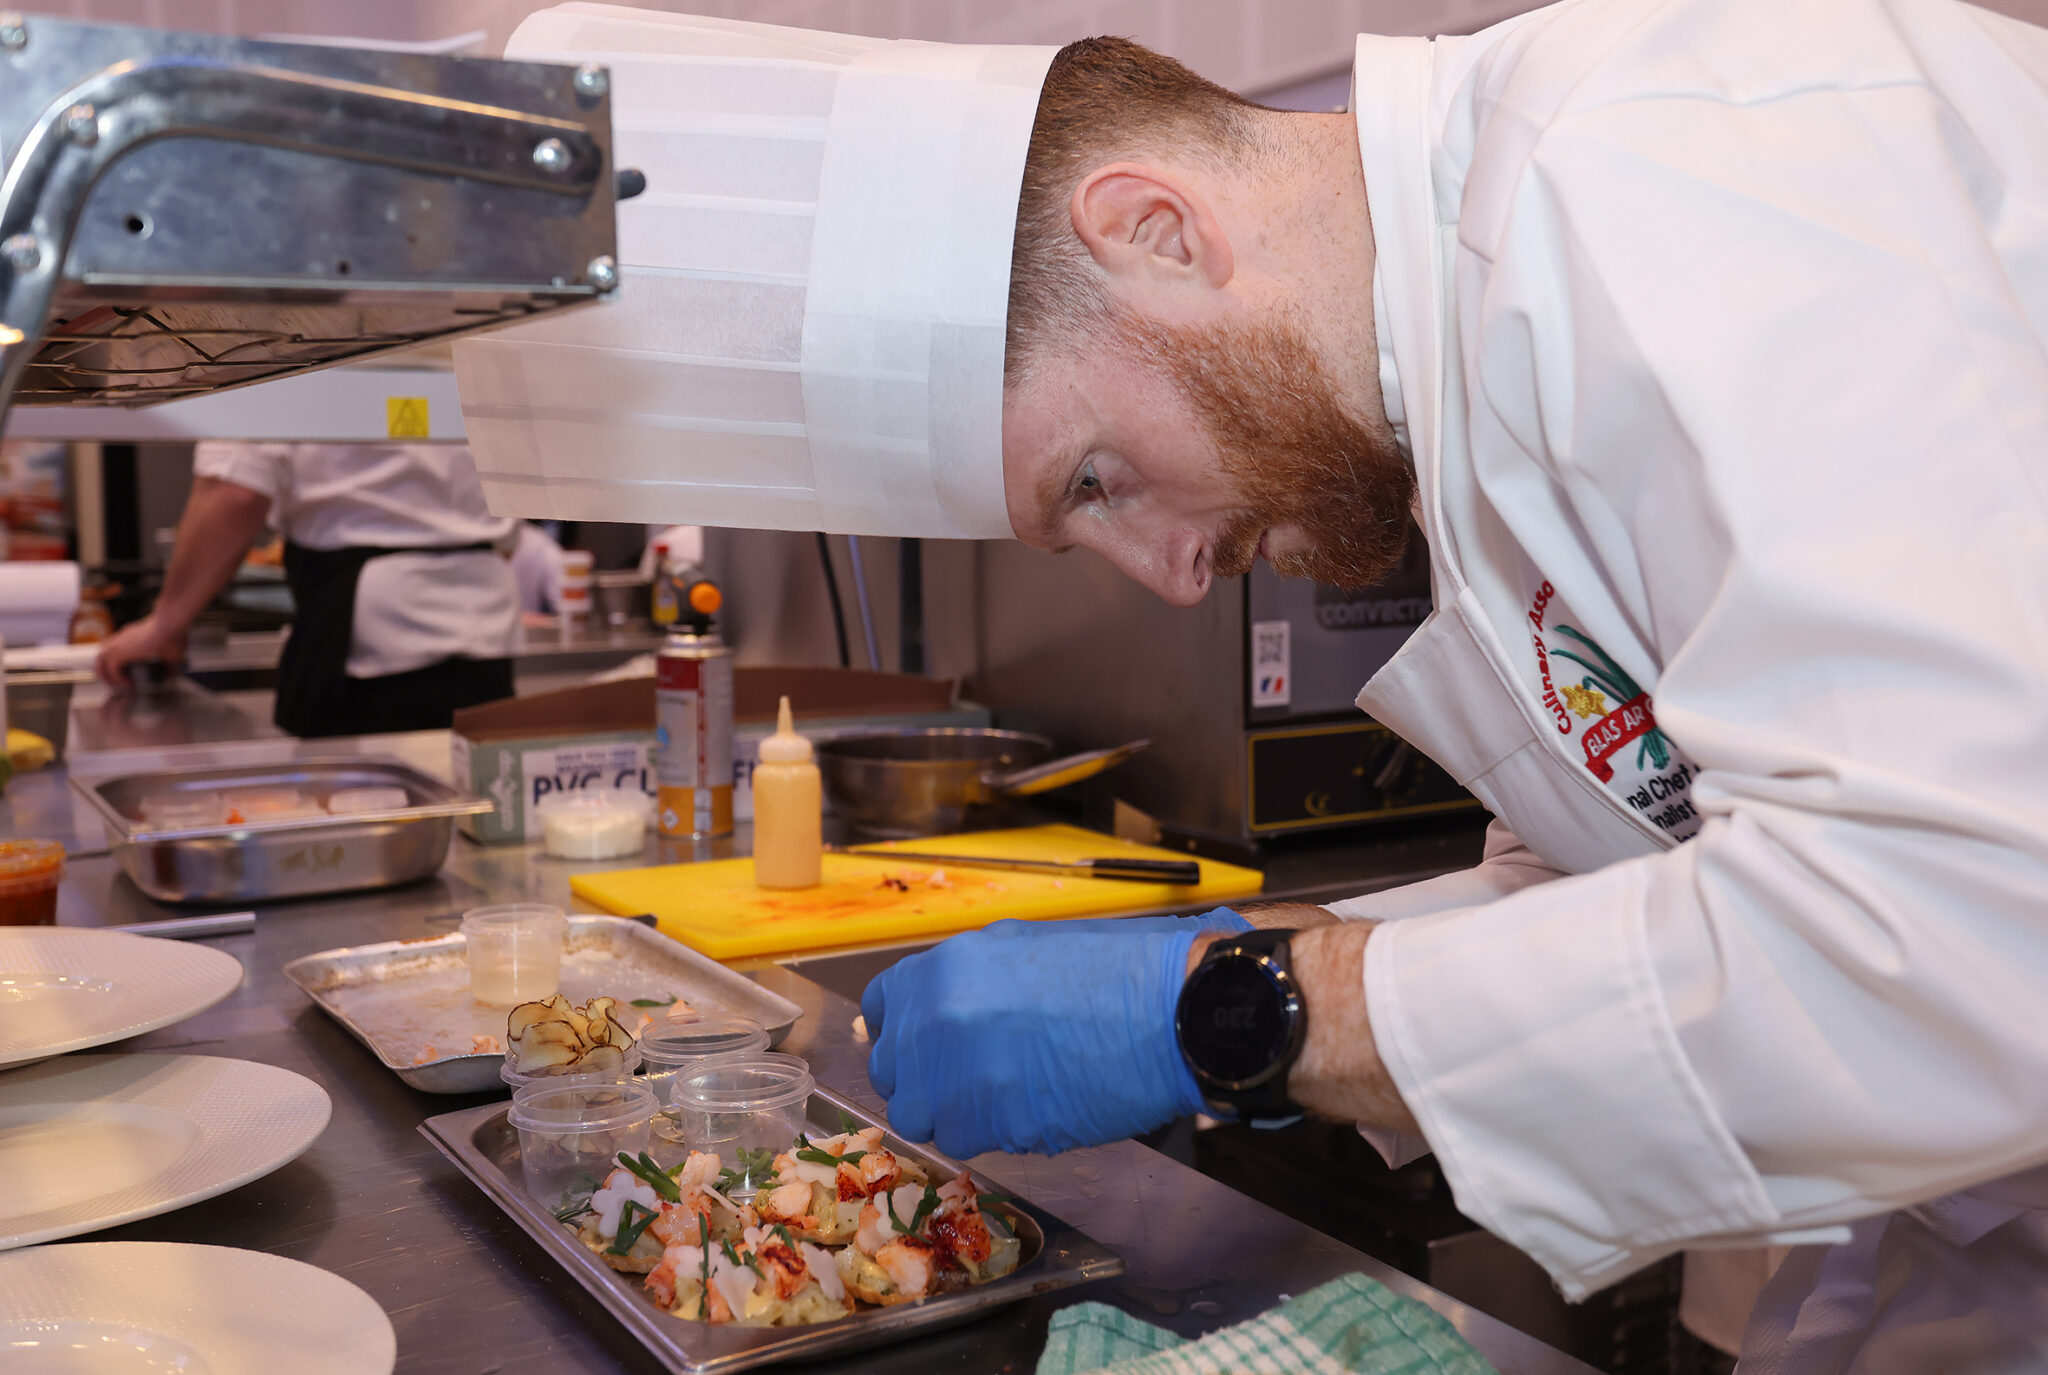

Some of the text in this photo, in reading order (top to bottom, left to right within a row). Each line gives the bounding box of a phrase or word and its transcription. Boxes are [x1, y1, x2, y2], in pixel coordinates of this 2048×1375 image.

[1528, 579, 1572, 735] Culinary Asso
[1586, 718, 1622, 758] BLAS
[1622, 704, 1646, 732] AR
[1648, 763, 1693, 801] Chef
